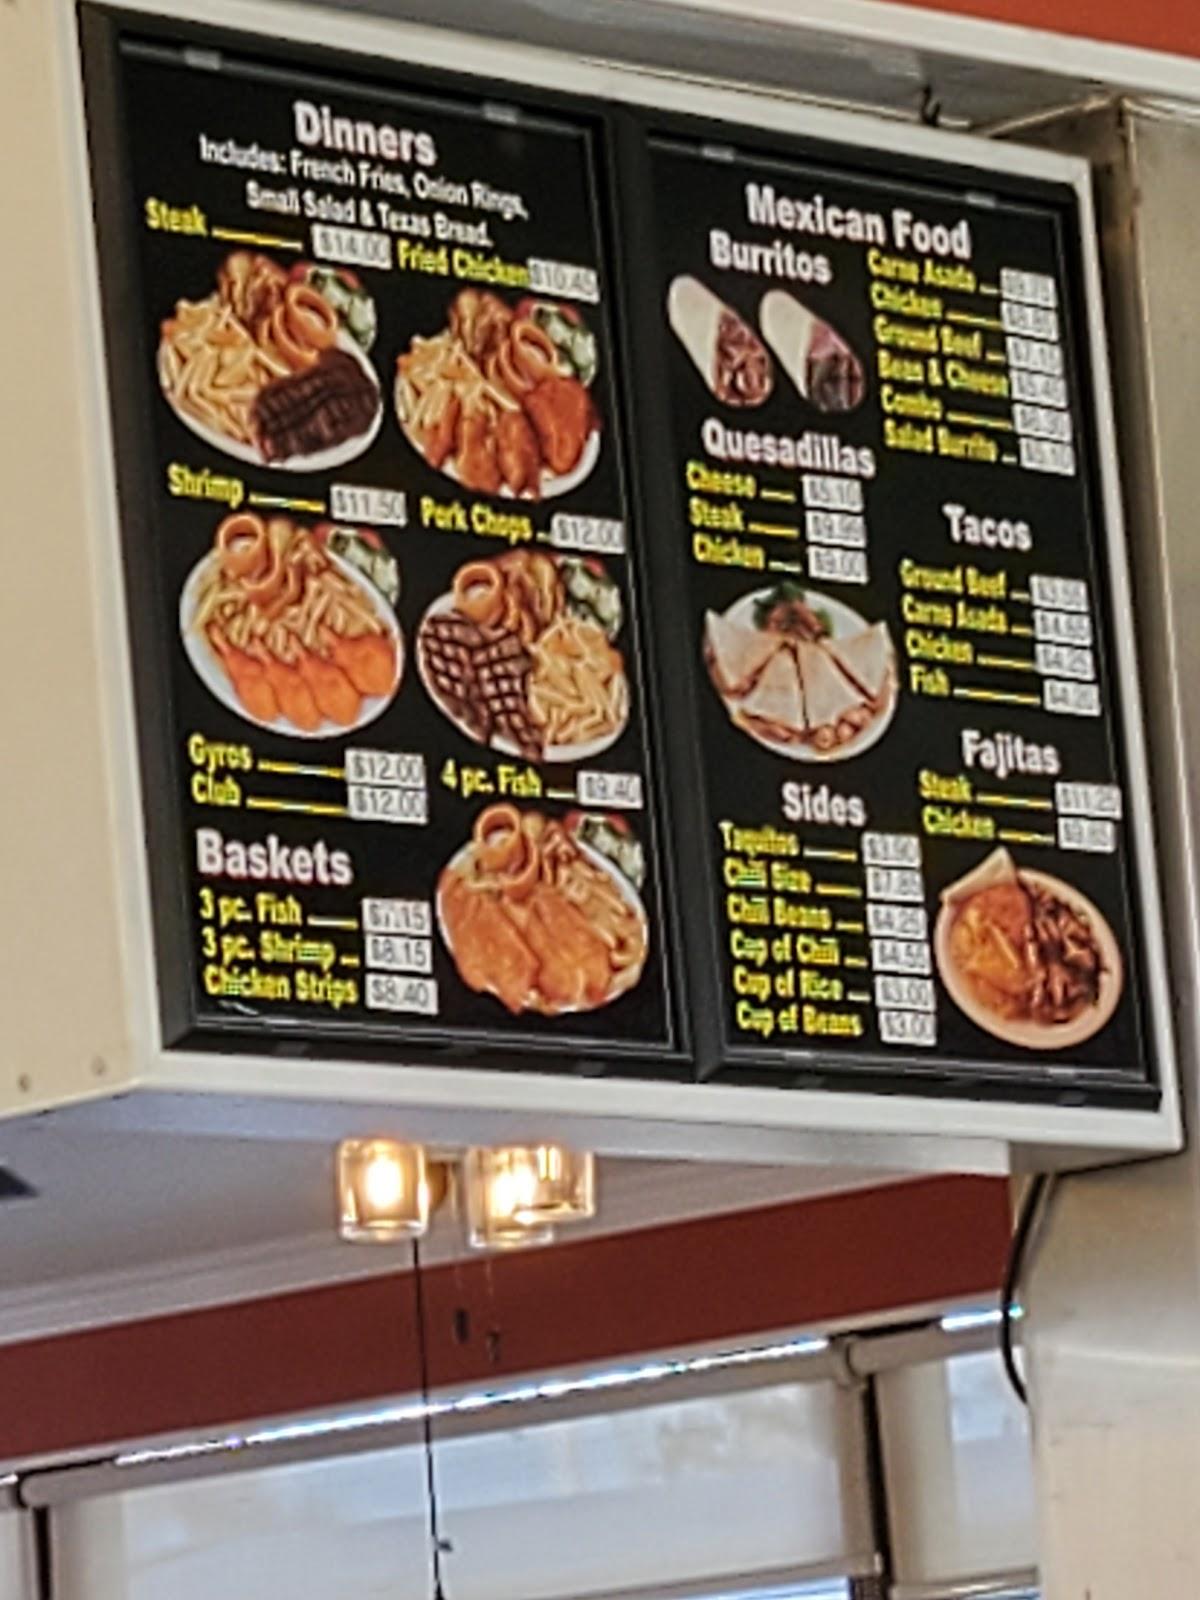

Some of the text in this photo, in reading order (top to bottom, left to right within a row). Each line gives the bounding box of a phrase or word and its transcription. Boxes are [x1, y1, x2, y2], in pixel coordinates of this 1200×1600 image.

[293, 100, 438, 166] Dinners
[200, 133, 287, 175] Includes:
[290, 148, 356, 187] French
[413, 171, 469, 206] Onion
[145, 196, 208, 237] Steak
[246, 179, 300, 216] Small
[302, 188, 356, 224] Salad
[359, 199, 376, 228] &
[377, 202, 431, 237] Texas
[745, 182, 972, 260] Mexican Food
[397, 238, 450, 276] Fried
[452, 248, 530, 289] Chicken
[709, 229, 833, 285] Burritos
[867, 247, 920, 284] Carne
[923, 258, 976, 293] Asada
[871, 281, 943, 318] Chicken
[874, 314, 939, 352] Ground
[702, 417, 876, 479] Quesadillas
[167, 462, 244, 510] Shrimp
[686, 460, 757, 499] Cheese
[420, 496, 469, 532] Pork
[470, 502, 533, 546] Chops
[689, 496, 745, 532] Steak
[942, 503, 1032, 552] Tacos
[693, 531, 765, 571] Chicken
[900, 558, 964, 595] Ground
[903, 593, 953, 628] Carne
[906, 628, 974, 665] Chicken
[910, 663, 950, 697] Fish
[188, 732, 252, 773] Gyros
[961, 729, 1061, 779] Fajitas
[191, 771, 242, 807] Club
[441, 758, 458, 790] 4
[497, 765, 542, 797] Fish
[919, 768, 973, 803] Steak
[781, 781, 867, 827] Sides
[922, 804, 995, 840] Chicken
[196, 827, 354, 886] Baskets
[724, 856, 768, 889] Chili
[199, 887, 215, 920] 3
[218, 896, 253, 928] pc.
[255, 892, 303, 926] Fish
[727, 893, 770, 925] Chili
[774, 896, 832, 931] Beans
[201, 926, 217, 957] 3
[220, 934, 255, 966] pc.
[259, 930, 335, 971] Shrimp
[730, 929, 769, 967] Cup
[772, 932, 792, 962] of
[796, 933, 840, 966] Chili
[204, 963, 291, 999] Chicken
[295, 970, 359, 1010] Strips
[733, 964, 771, 1002] Cup
[775, 968, 795, 998] of
[799, 968, 843, 1001] Rice
[736, 1000, 775, 1039] Cup
[778, 1003, 798, 1033] of
[802, 1004, 863, 1037] Beans
